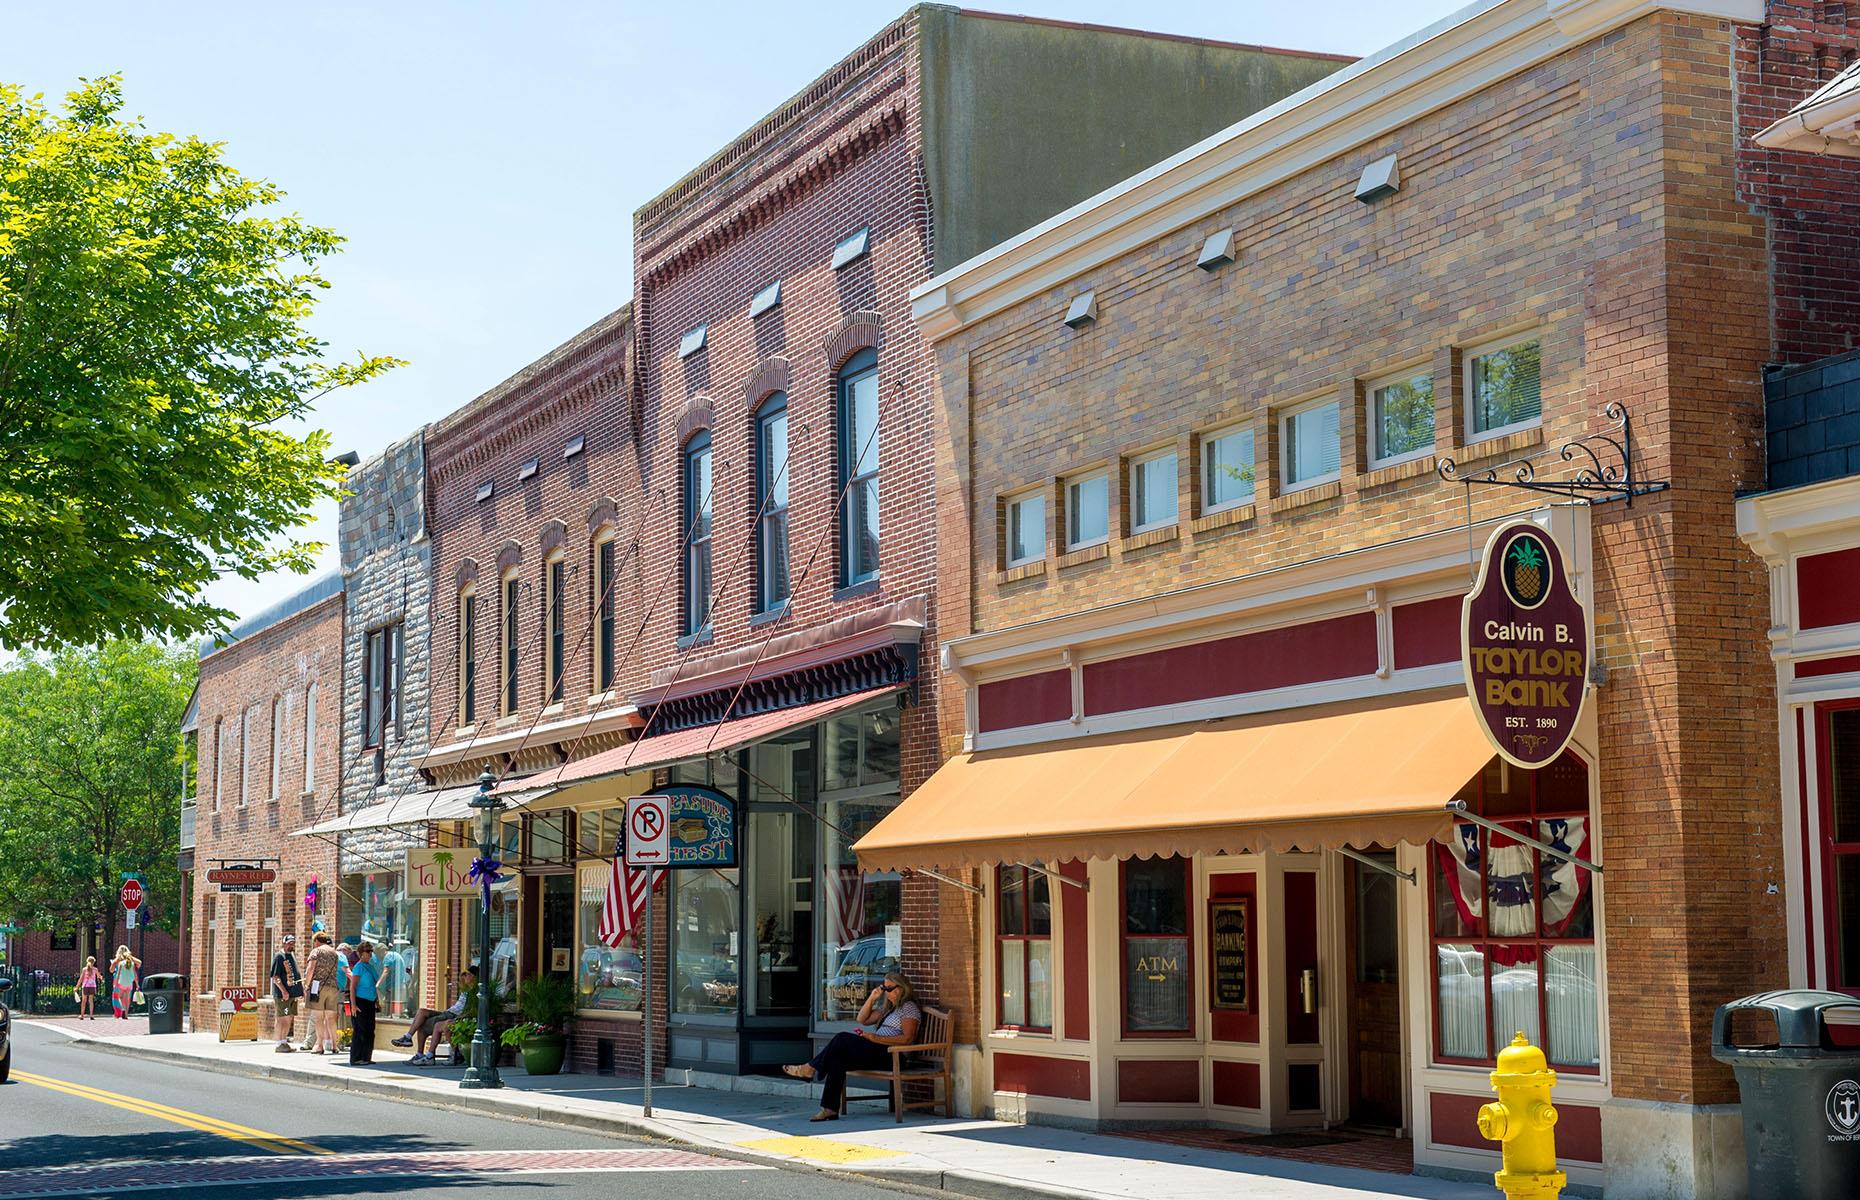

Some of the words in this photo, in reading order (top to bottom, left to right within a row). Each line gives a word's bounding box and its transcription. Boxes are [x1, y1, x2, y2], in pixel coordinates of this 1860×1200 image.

[1484, 620, 1544, 642] Calvin
[1555, 624, 1574, 643] B.
[1505, 717, 1529, 728] EST.
[1536, 718, 1558, 729] 1890
[411, 862, 434, 887] Ta
[123, 889, 141, 901] STOP
[1216, 932, 1245, 952] BANKING
[1136, 956, 1179, 971] ATM
[223, 988, 255, 1000] OPEN
[1828, 1134, 1846, 1142] TOWN
